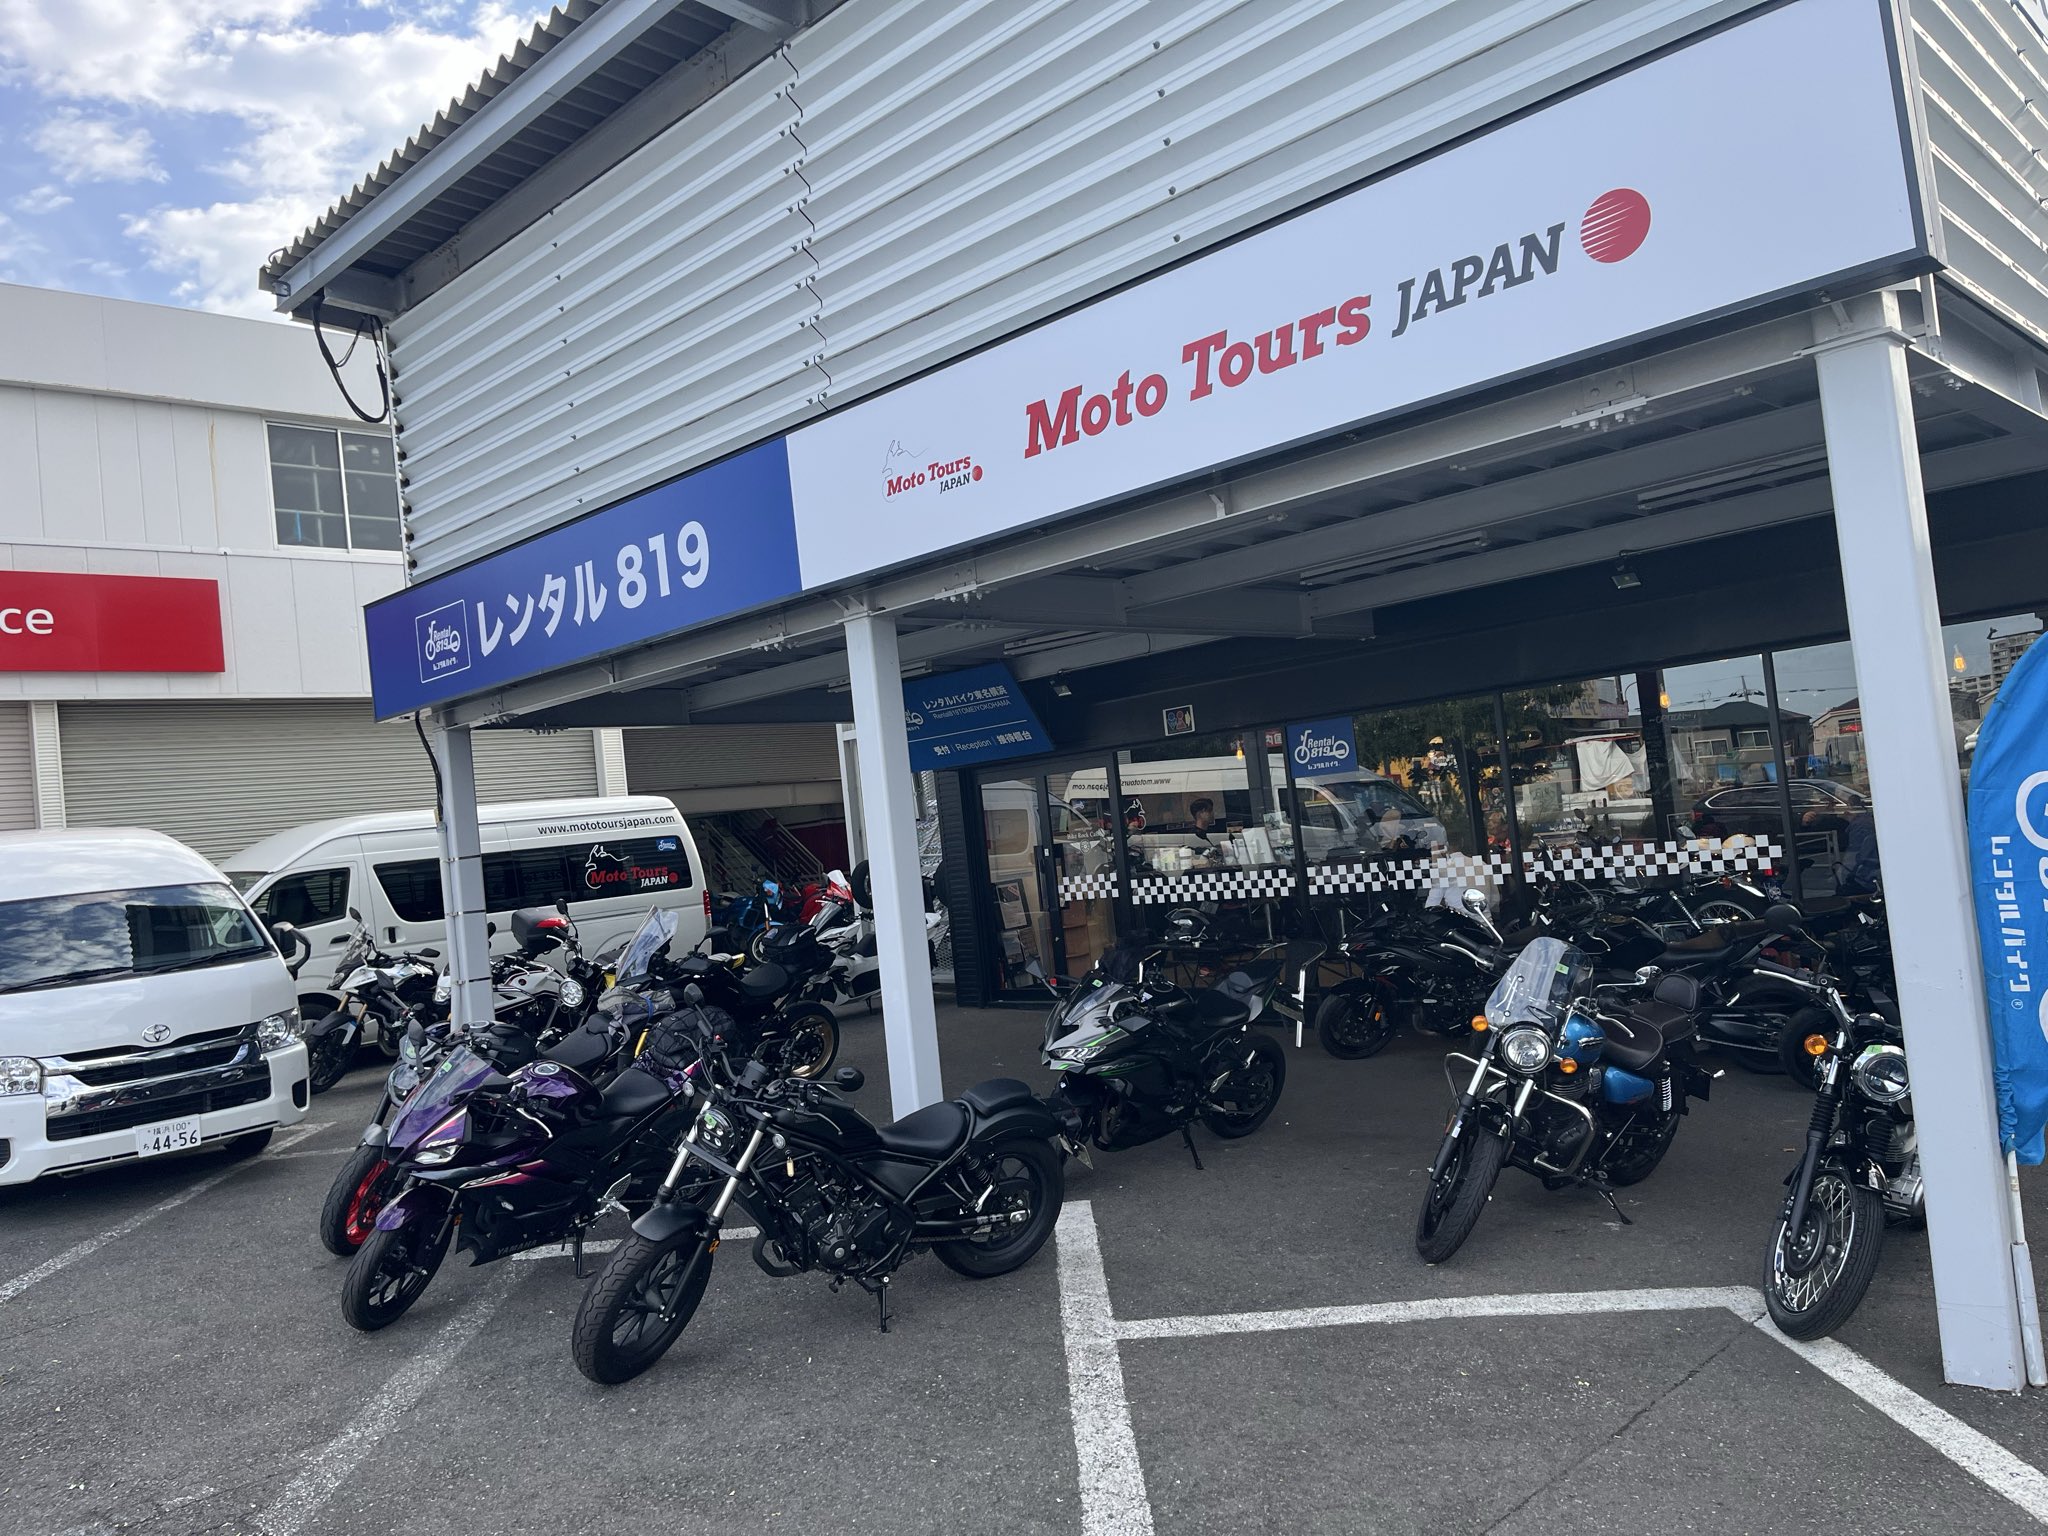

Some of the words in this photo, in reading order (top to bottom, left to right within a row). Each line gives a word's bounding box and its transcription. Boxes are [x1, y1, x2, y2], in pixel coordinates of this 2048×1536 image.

[1024, 370, 1168, 459] Moto
[1181, 294, 1372, 402] Tours
[1391, 221, 1565, 338] JAPAN
[886, 472, 925, 497] Moto
[928, 456, 971, 481] Tours
[940, 472, 971, 494] JAPAN
[0, 608, 54, 635] ce
[435, 638, 449, 653] 819
[955, 739, 992, 753] Reception
[1307, 735, 1335, 748] Rental
[1310, 746, 1330, 757] 819
[537, 814, 676, 835] www.mototoursjapan.com
[590, 870, 628, 885] Moto
[630, 866, 668, 880] Tours
[640, 875, 668, 888] JAPAN
[153, 1125, 170, 1136] 横浜
[172, 1122, 187, 1132] 100
[153, 1129, 197, 1152] 44-56
[497, 1240, 537, 1255] YAMAHA
